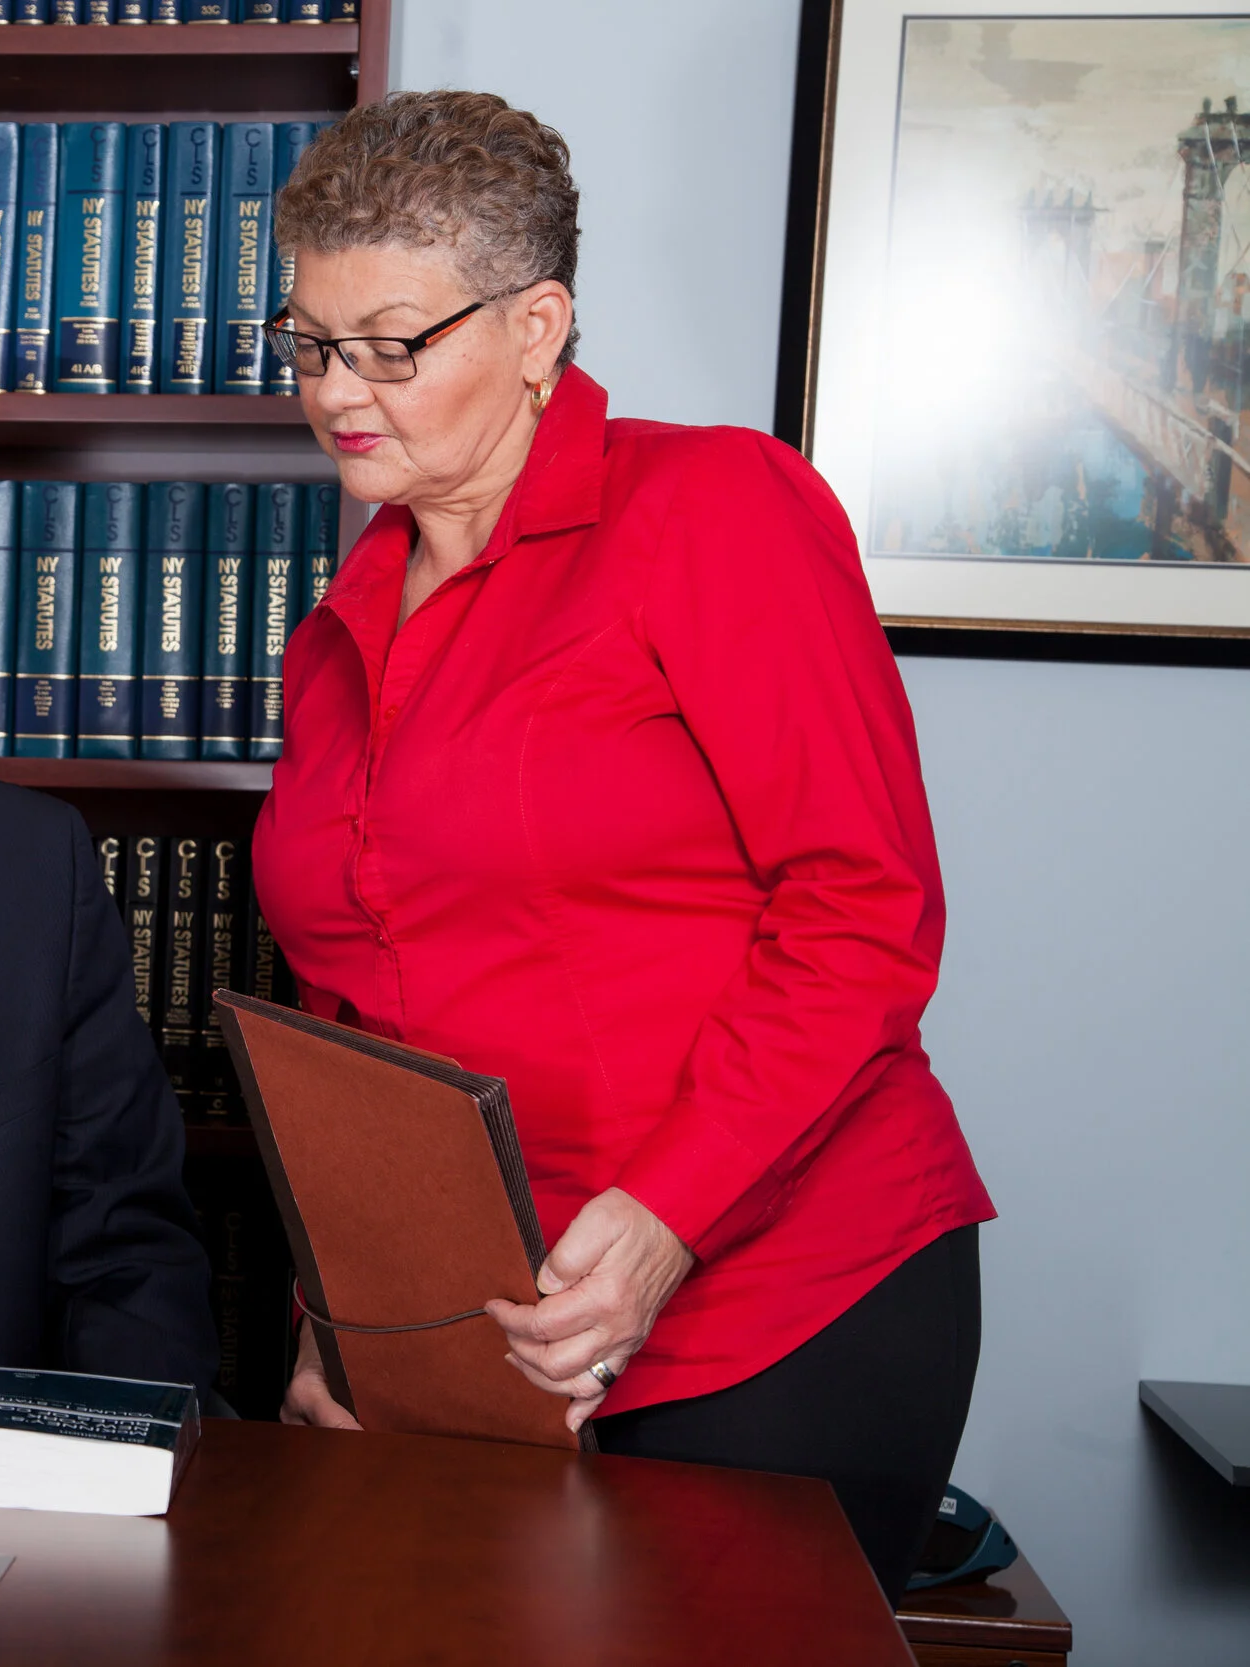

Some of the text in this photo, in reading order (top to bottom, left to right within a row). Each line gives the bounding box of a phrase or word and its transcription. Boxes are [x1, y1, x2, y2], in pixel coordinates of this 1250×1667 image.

[80, 198, 104, 293] NY STATUTES
[134, 200, 160, 295] NY STATUTES
[182, 199, 207, 294] NY STATUTES
[238, 201, 261, 296] NY STATUTES
[71, 364, 82, 373] 41
[36, 556, 59, 650] NY STATUTES
[99, 557, 123, 651] NY STATUTES
[161, 557, 185, 652] NY STATUTES
[218, 558, 241, 655] NY STATUTES
[267, 559, 291, 575] NY
[266, 576, 287, 656] STATUTES
[136, 837, 155, 897] CLS
[178, 839, 197, 898] CLS
[215, 841, 235, 900] CLS
[133, 910, 153, 1004] NY STATUTES
[174, 911, 193, 928] NY
[213, 913, 233, 929] NY
[172, 930, 192, 1005] STATUTES
